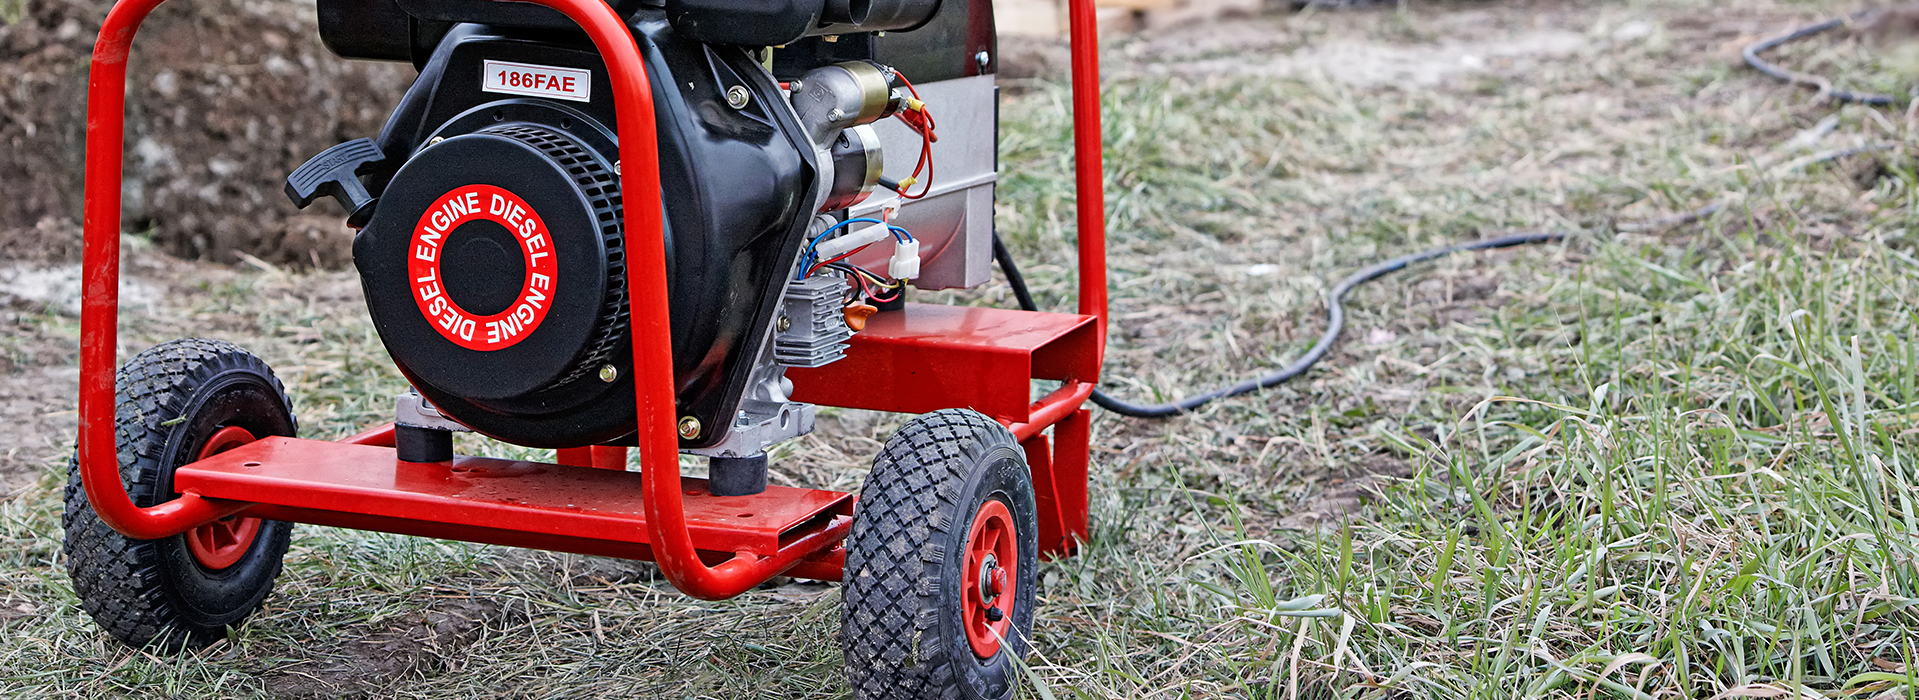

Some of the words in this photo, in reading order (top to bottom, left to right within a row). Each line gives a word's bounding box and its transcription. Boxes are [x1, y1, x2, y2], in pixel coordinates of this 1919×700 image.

[498, 70, 575, 92] 186FAE
[323, 153, 347, 170] START
[416, 192, 481, 262] ENGINE
[489, 193, 549, 267] DIESEL
[417, 267, 476, 342] DIESEL
[485, 272, 550, 344] ENGINE
